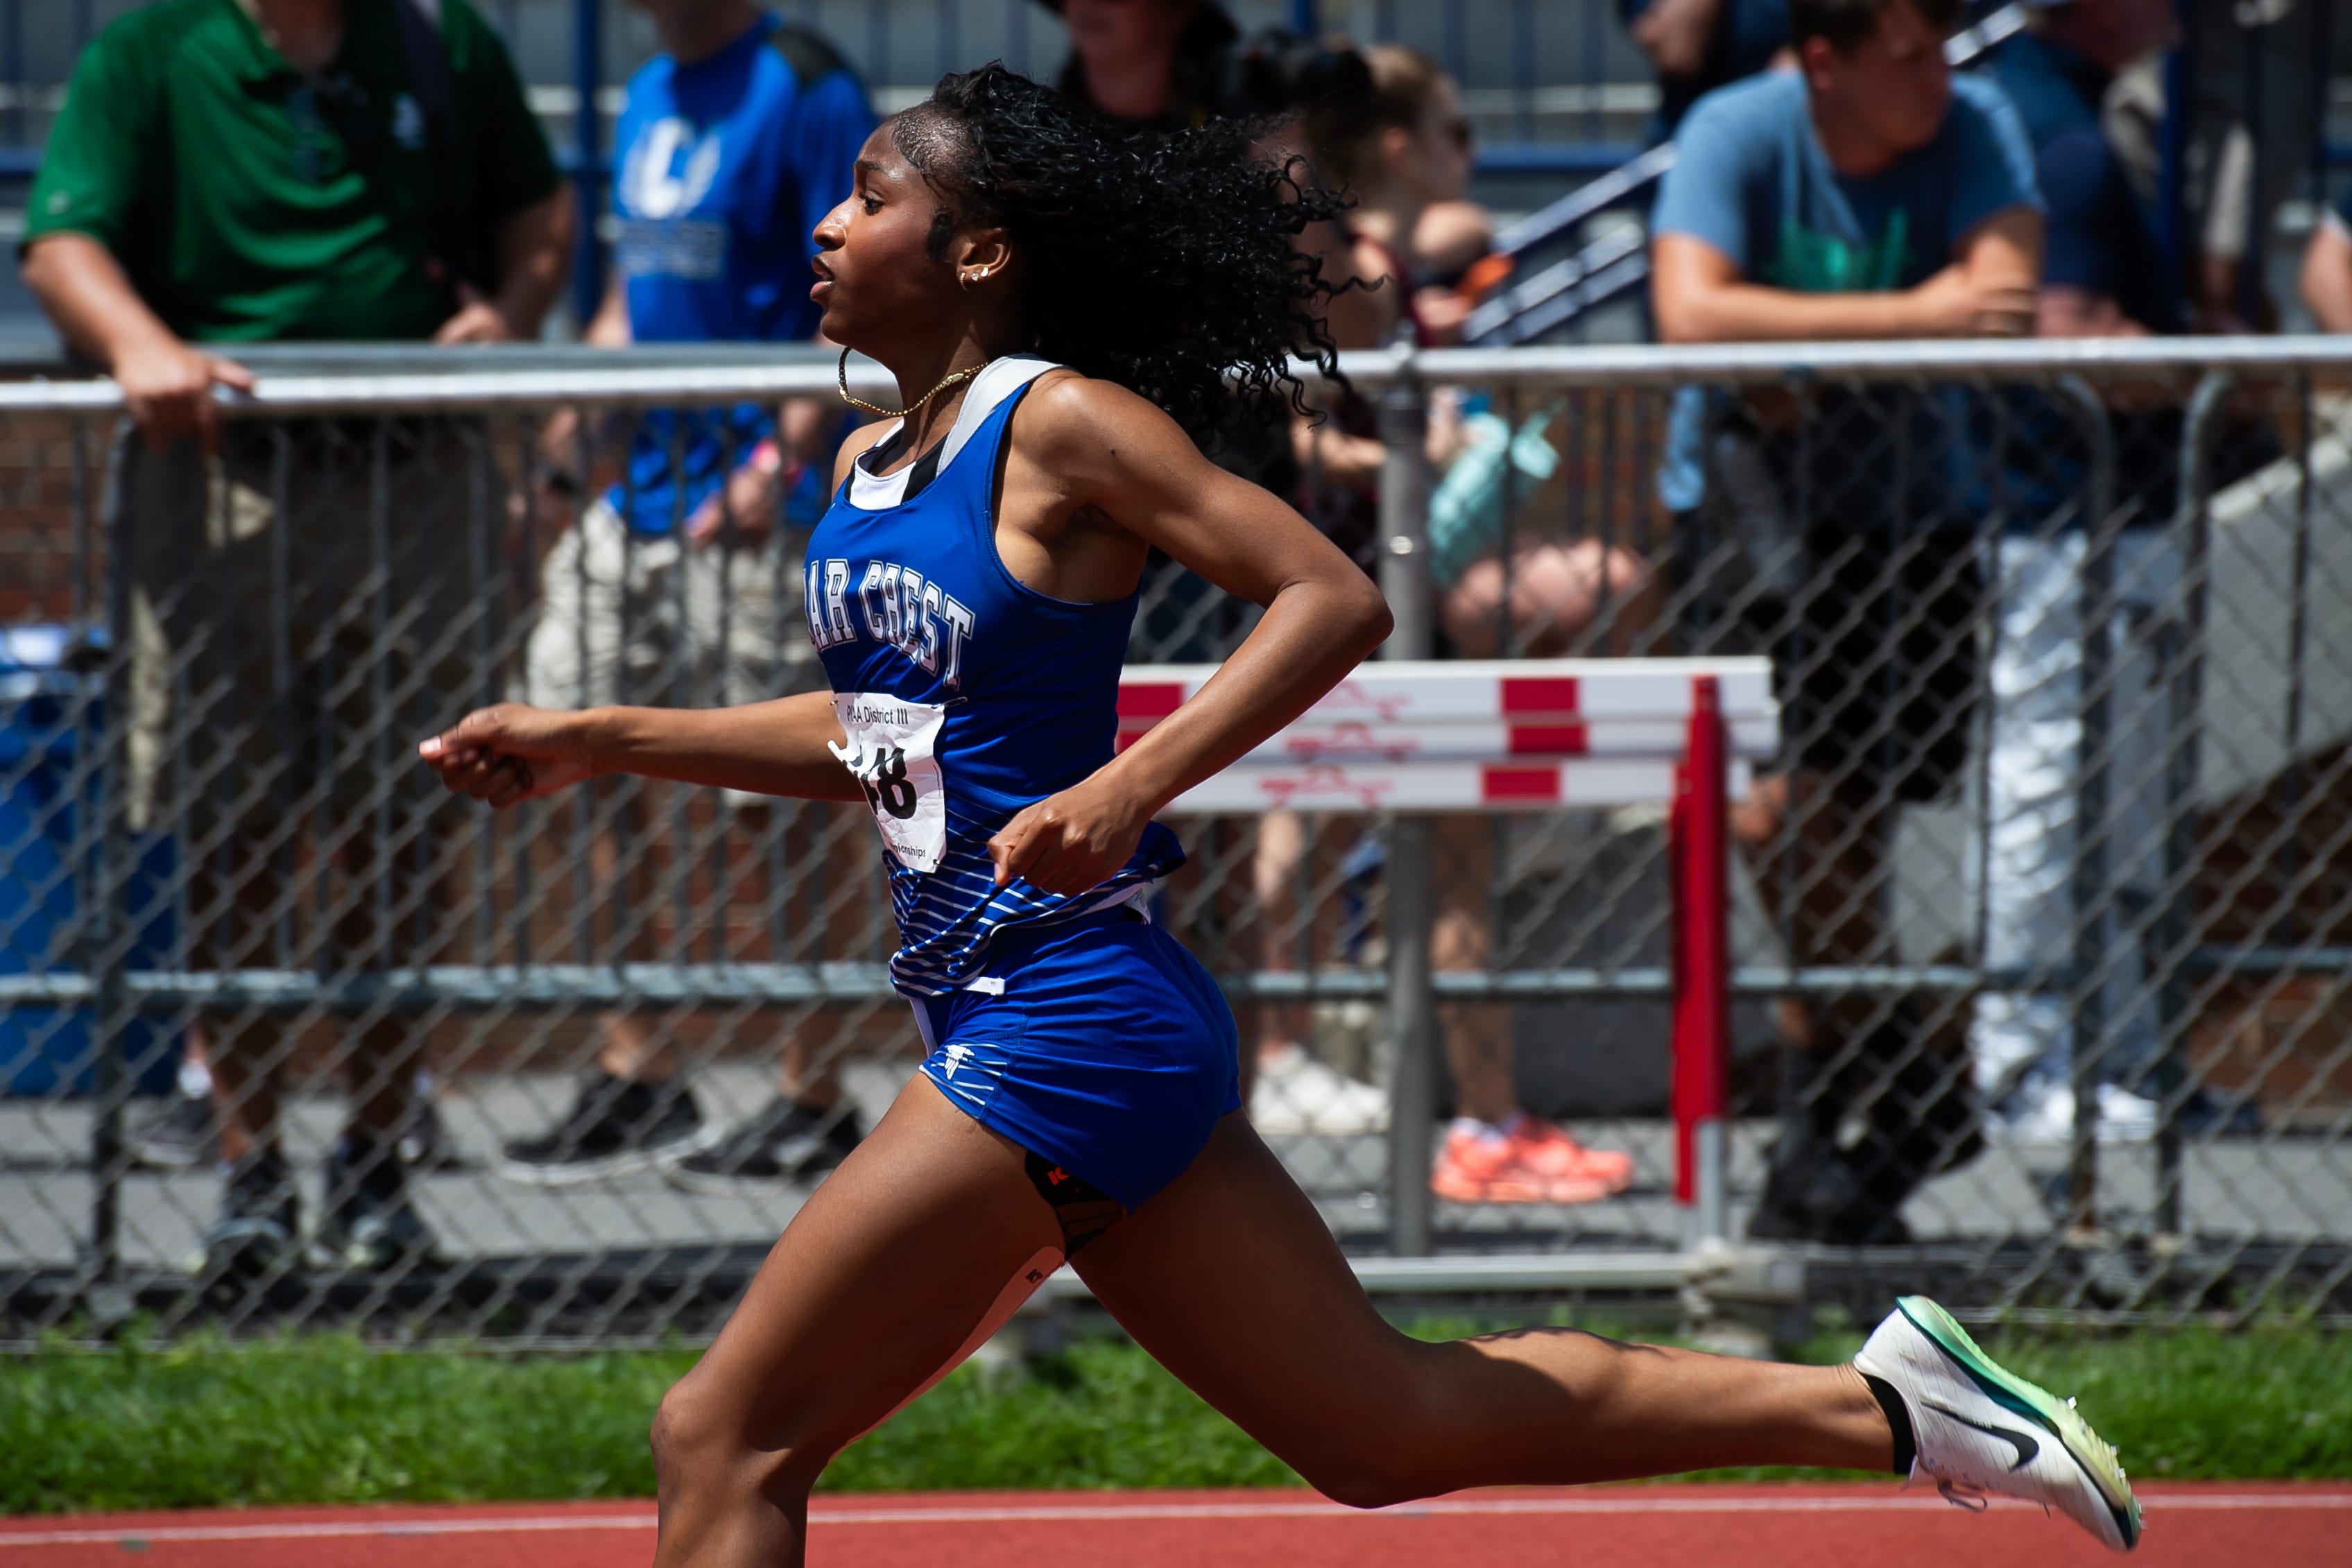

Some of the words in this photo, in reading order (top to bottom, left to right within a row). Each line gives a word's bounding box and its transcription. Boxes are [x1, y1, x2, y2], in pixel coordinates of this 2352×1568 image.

[804, 558, 858, 653] AR
[859, 560, 975, 691] CREST
[864, 706, 894, 725] District
[897, 707, 909, 725] III
[892, 842, 926, 859] pionships
